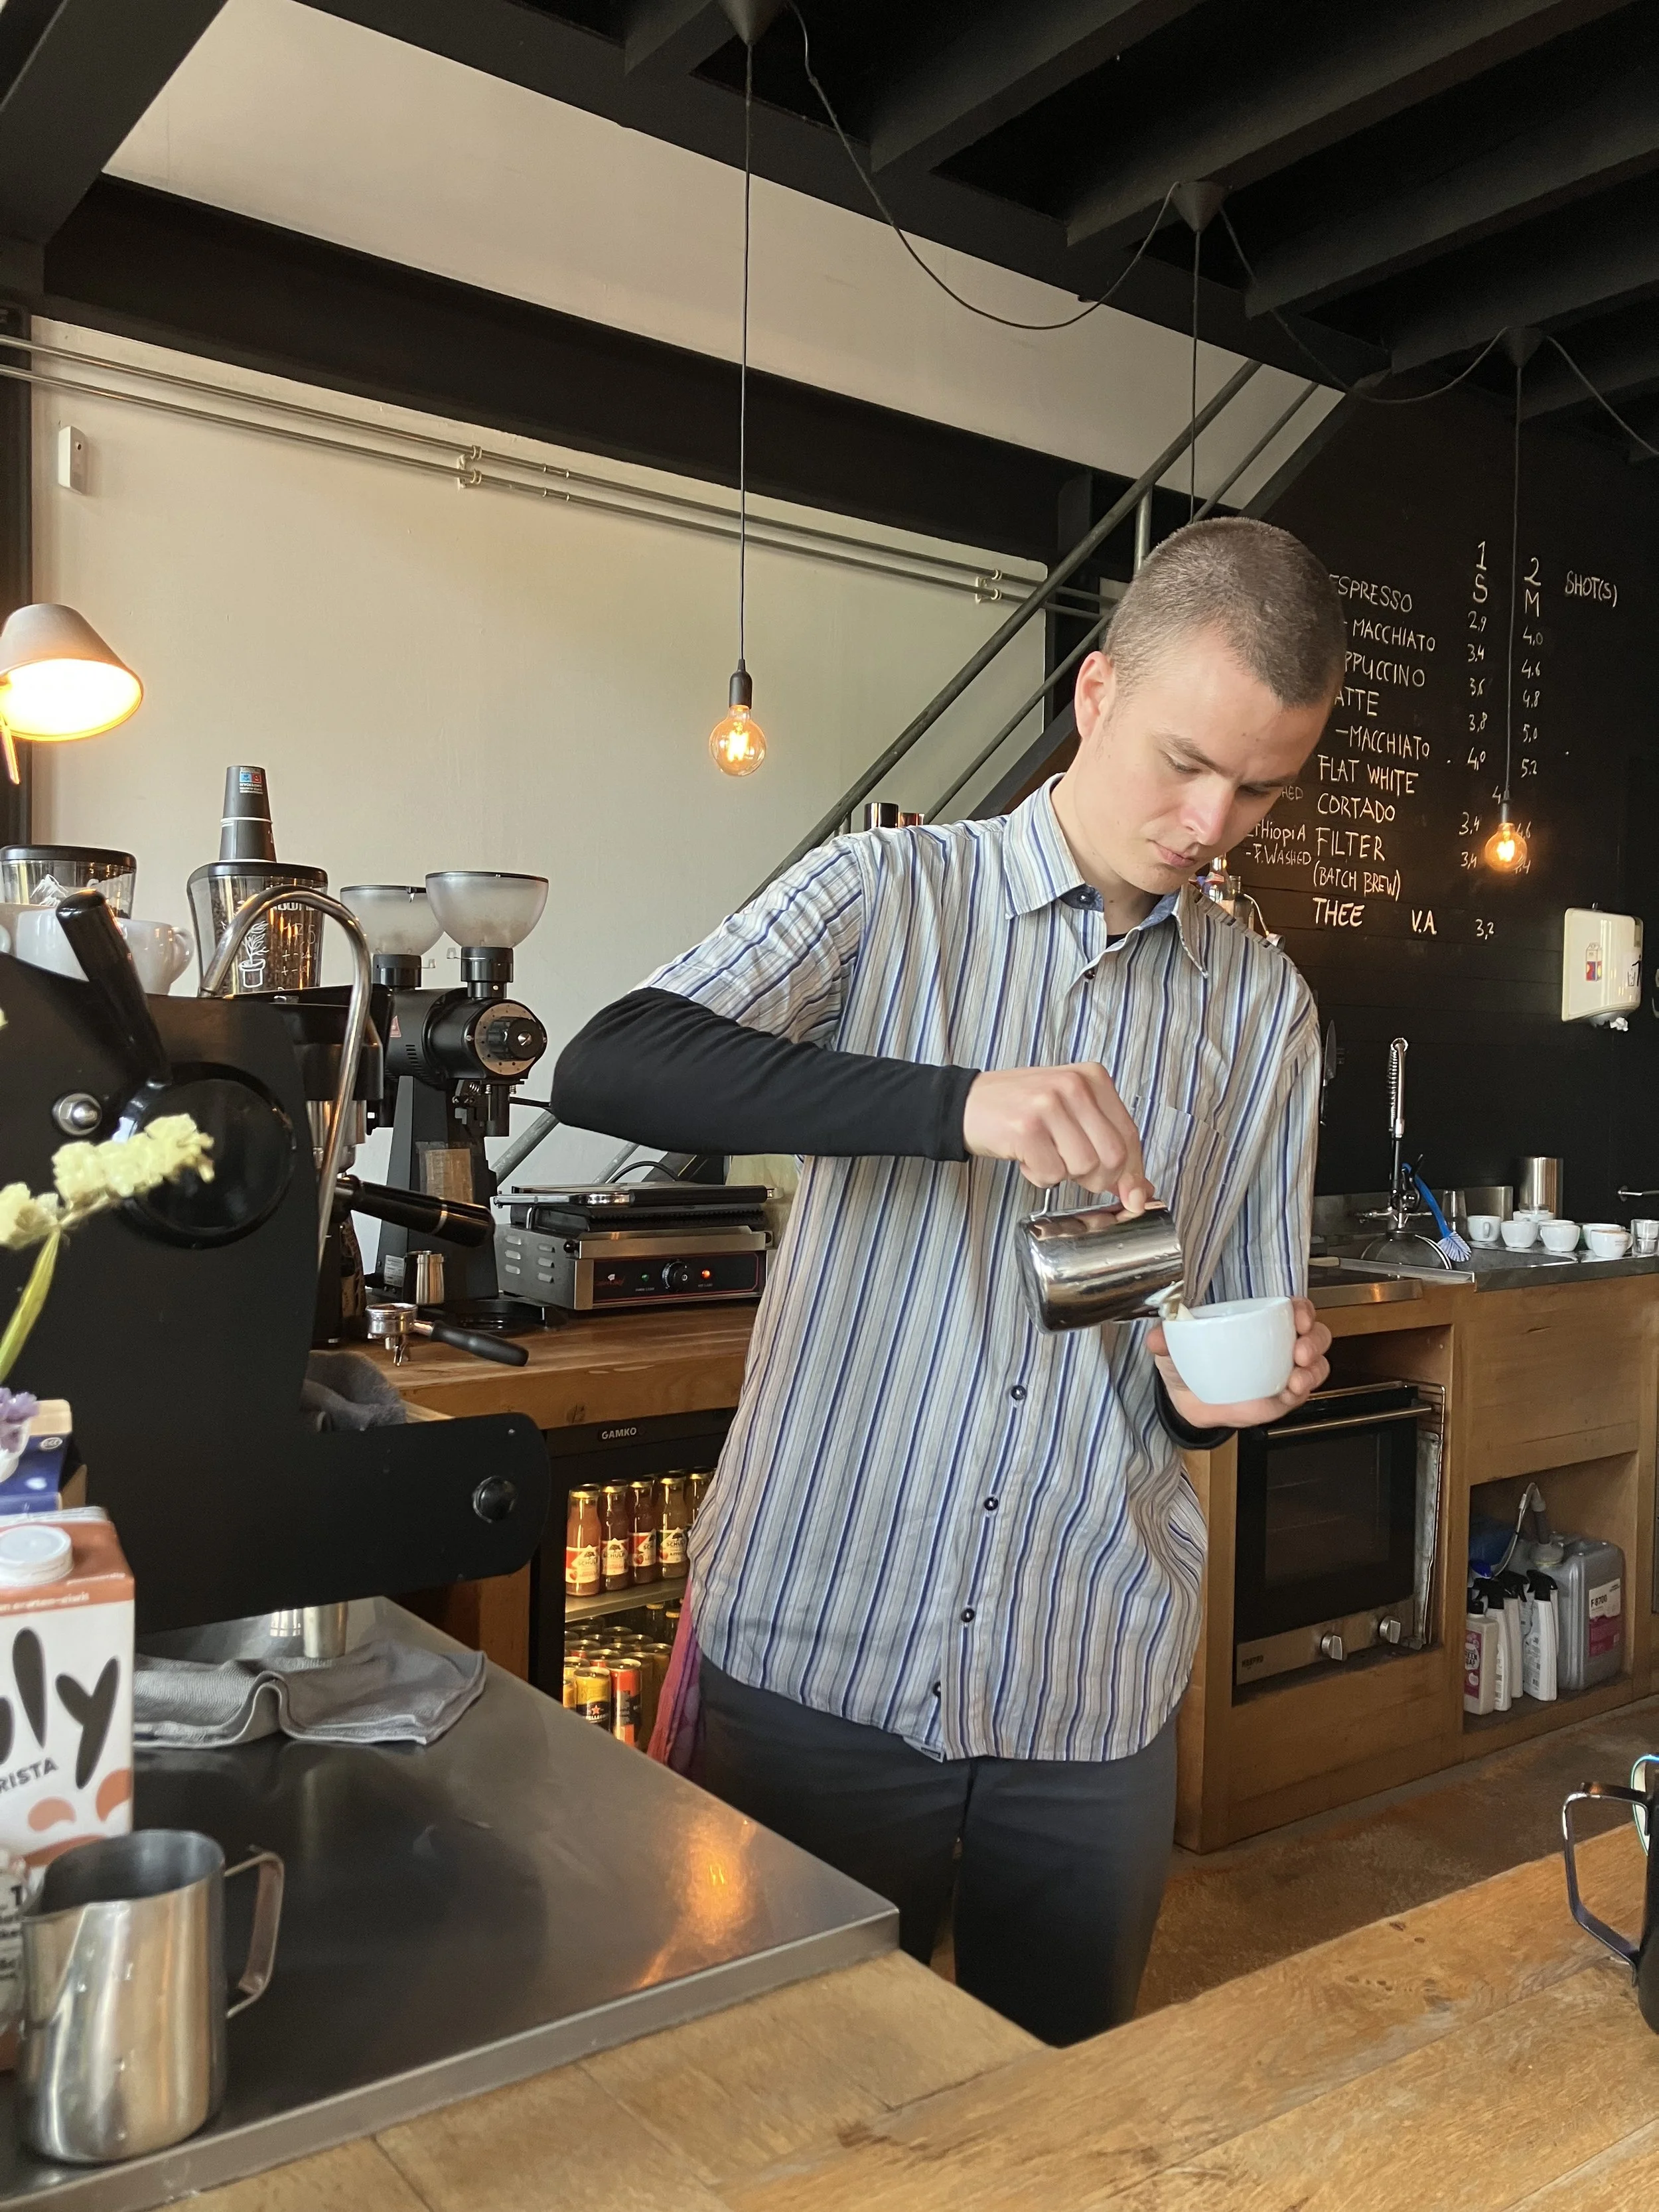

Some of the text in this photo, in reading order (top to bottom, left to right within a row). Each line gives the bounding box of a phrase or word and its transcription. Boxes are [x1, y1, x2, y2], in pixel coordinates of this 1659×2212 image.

[1476, 541, 1487, 571] 1
[1524, 557, 1542, 587] 2
[1473, 573, 1540, 617] S M
[1344, 651, 1425, 688] PPUCCINO
[1334, 686, 1380, 716] ATTE
[1317, 754, 1360, 782] FLAT
[1367, 763, 1419, 796] WHITE
[1317, 792, 1396, 824] CORTADO
[1316, 827, 1386, 861] FILTER
[1313, 860, 1401, 902] (BATCH BREW)
[1313, 897, 1365, 927] THEE
[601, 1427, 637, 1439] GAMKO
[0, 1626, 121, 1791] ly
[0, 1757, 58, 1794] RISTA
